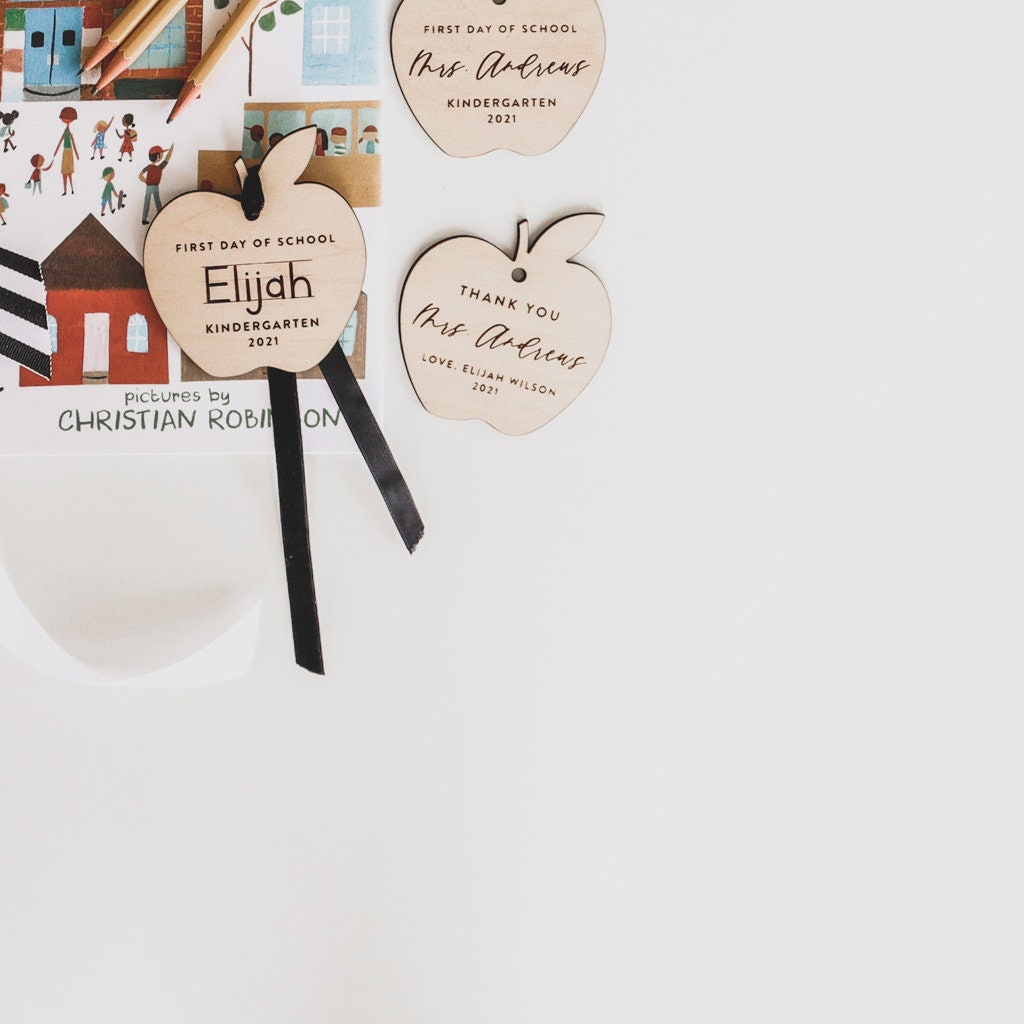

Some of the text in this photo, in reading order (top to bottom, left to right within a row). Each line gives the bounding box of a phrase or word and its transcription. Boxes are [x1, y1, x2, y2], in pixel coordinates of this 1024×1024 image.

[424, 24, 578, 34] FIRST DAY OF SCHOOL
[408, 49, 591, 80] Mrs. Andrews
[447, 98, 557, 108] KINDERGARTEN
[487, 114, 517, 124] 2021
[176, 234, 336, 253] FIRST DAY OF SCHOOL
[204, 261, 312, 315] Elijah
[460, 284, 560, 322] THANK YOU
[206, 317, 320, 334] KINDERGARTEN
[248, 336, 279, 348] 2021
[474, 323, 587, 370] Andrews
[462, 364, 505, 382] ELIJAH
[509, 376, 556, 396] WILSON
[472, 382, 498, 395] 2021
[125, 387, 230, 406] pictures by
[58, 408, 341, 431] CHRISTIAN ROBION
